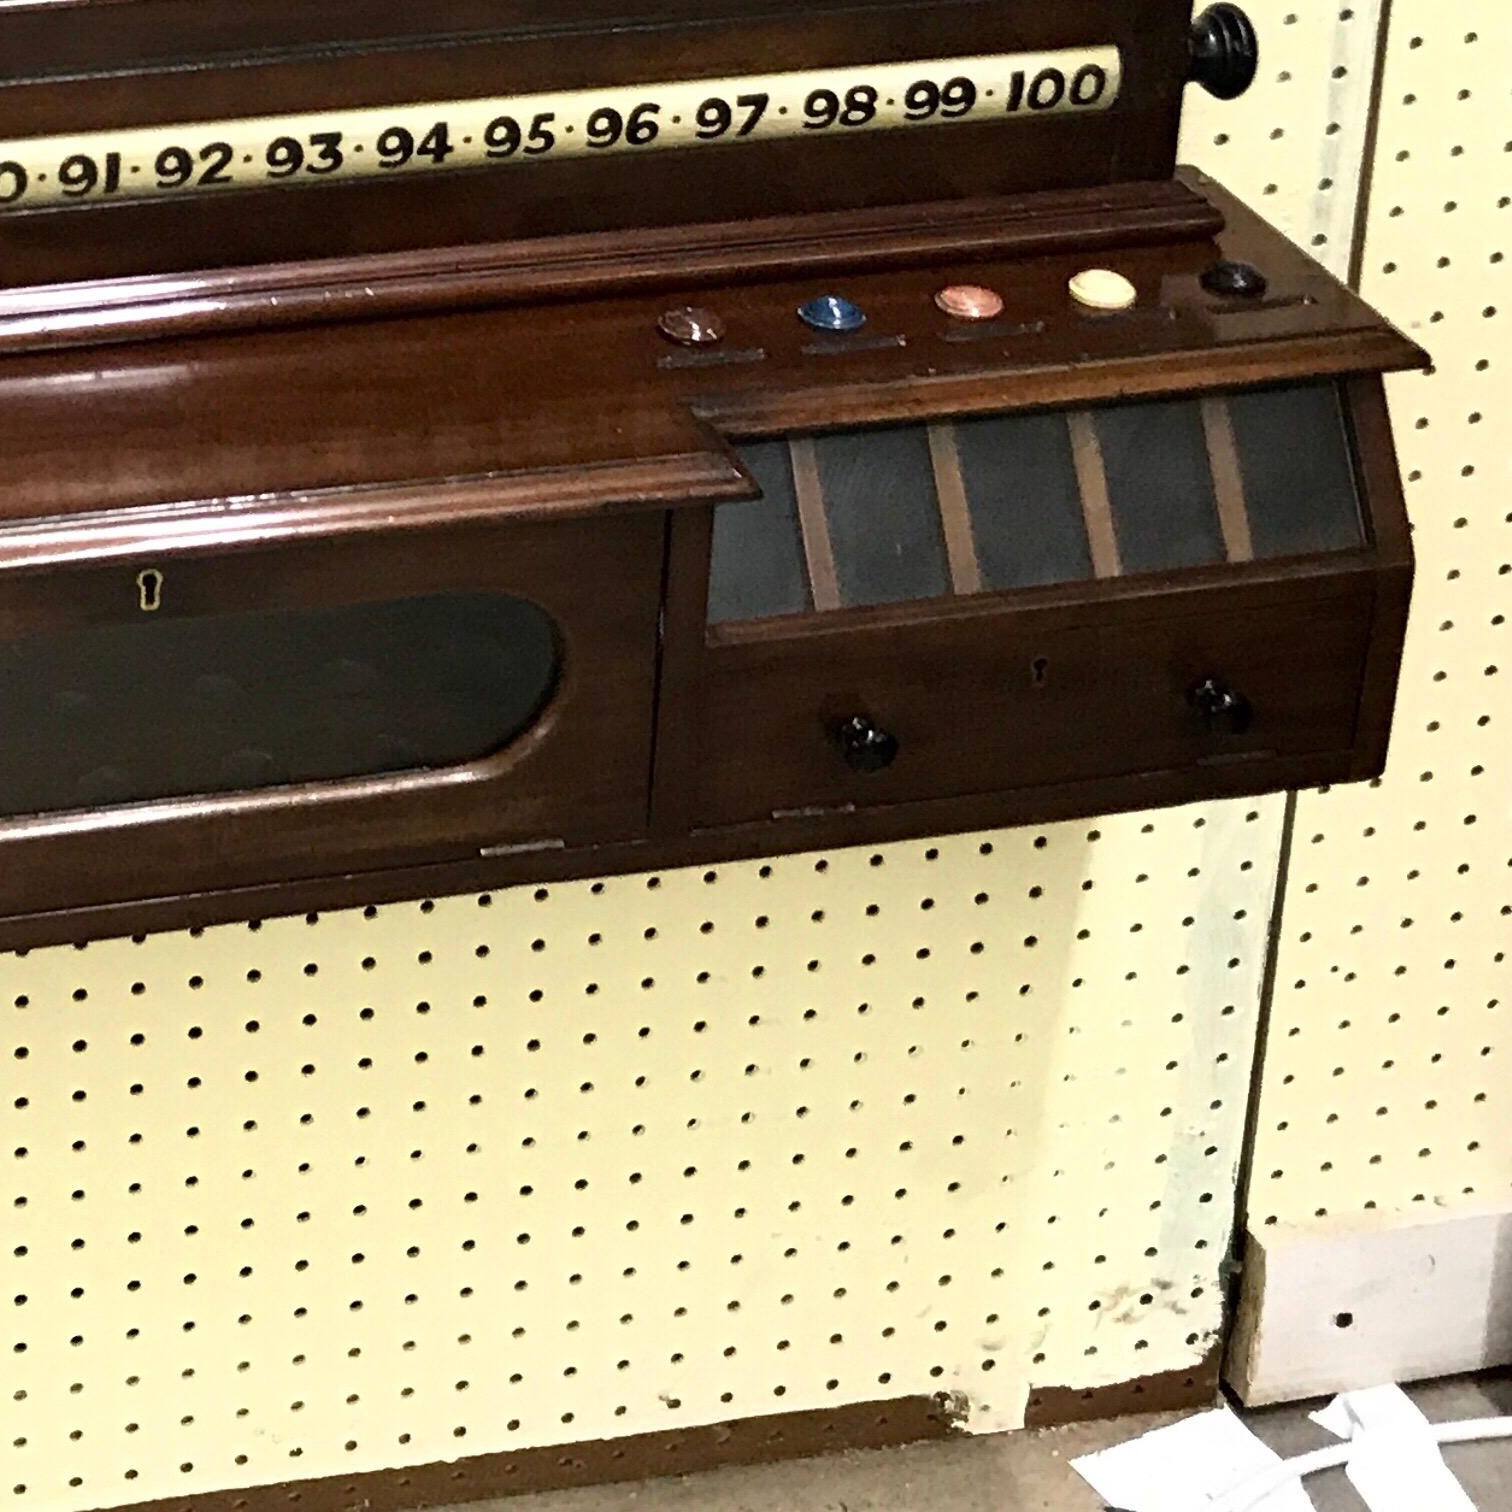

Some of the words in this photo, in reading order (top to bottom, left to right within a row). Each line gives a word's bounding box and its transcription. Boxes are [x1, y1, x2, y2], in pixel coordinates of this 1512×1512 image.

[58, 152, 120, 198] 91
[155, 142, 234, 188] 92
[265, 132, 344, 179] 93
[376, 122, 453, 169] 94
[484, 112, 556, 159] 95
[585, 103, 660, 150] 96
[695, 94, 768, 141] 97
[802, 84, 877, 130] 98
[903, 77, 976, 122] 99
[1006, 64, 1107, 113] 100
